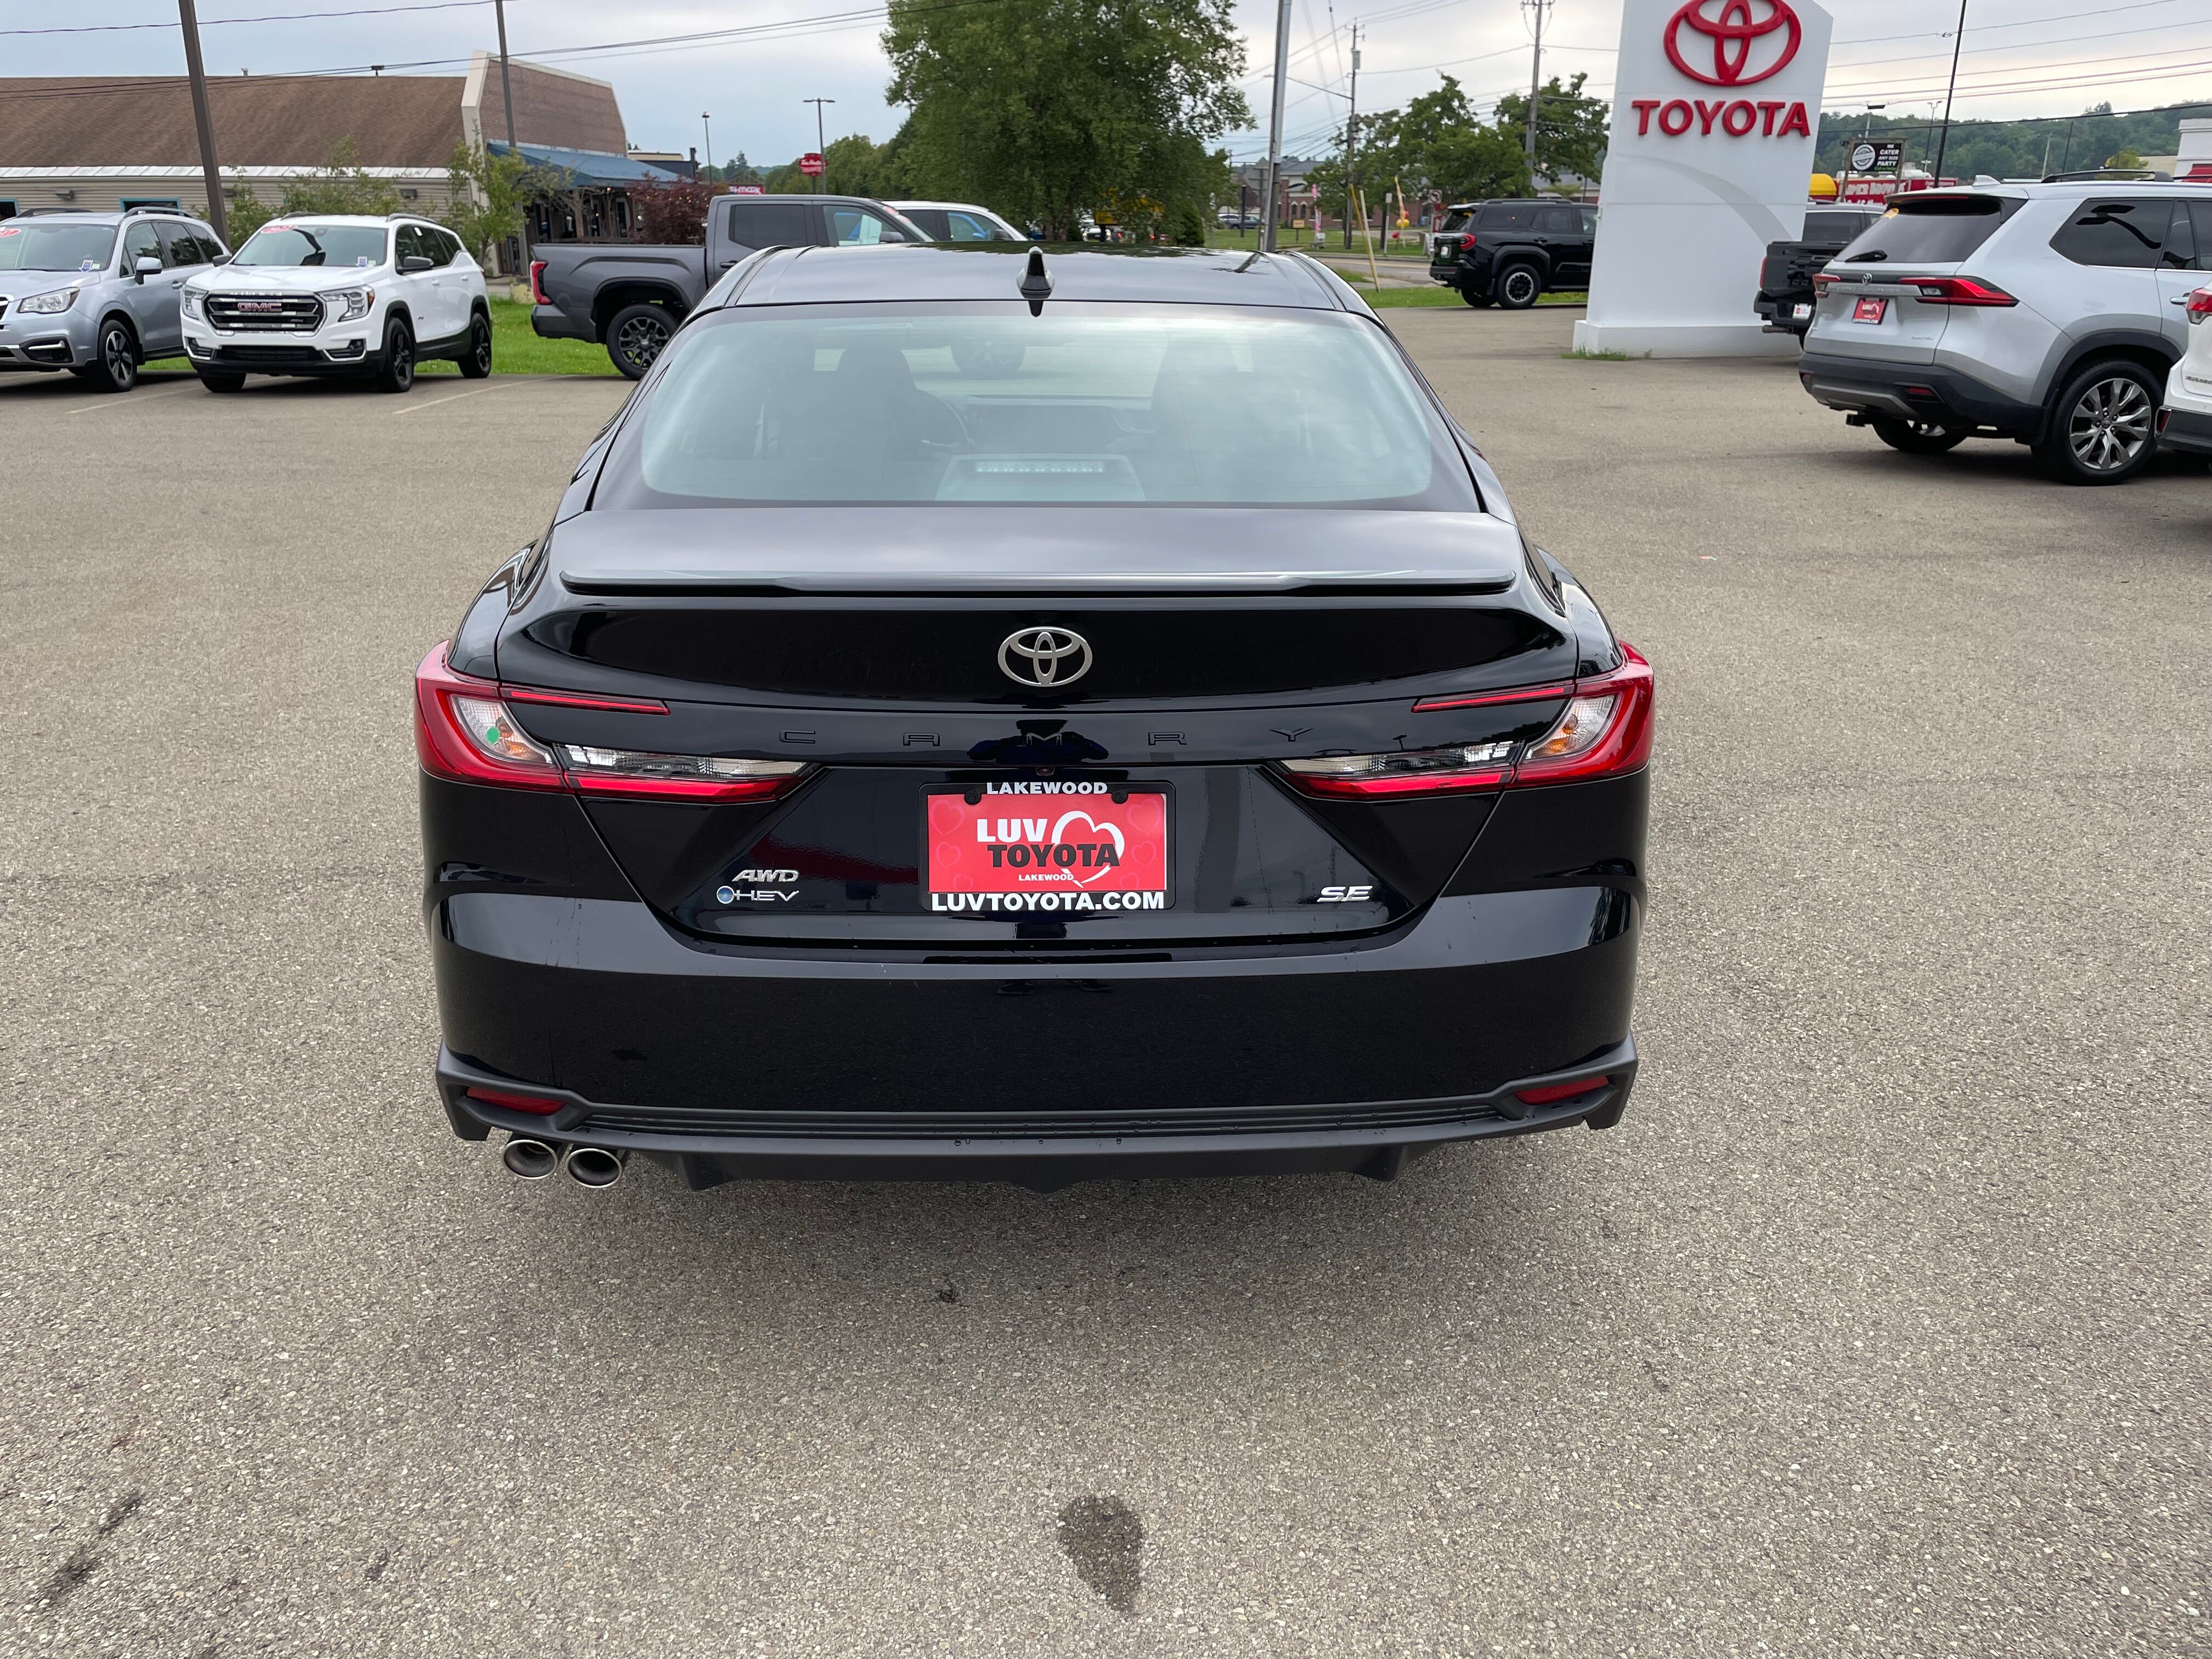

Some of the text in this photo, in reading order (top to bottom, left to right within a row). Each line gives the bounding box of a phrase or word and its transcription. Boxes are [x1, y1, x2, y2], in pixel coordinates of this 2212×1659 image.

[1632, 99, 1810, 137] TOYOTA
[238, 302, 283, 312] GMC
[779, 727, 1314, 747] CAMRY
[986, 782, 1108, 794] LAKEWOOD
[977, 819, 1048, 843] LUV
[988, 843, 1120, 868] TOYOTA
[732, 870, 799, 883] AWD
[932, 891, 1164, 911] LUVTOYOTA.COM
[1317, 885, 1373, 902] SE
